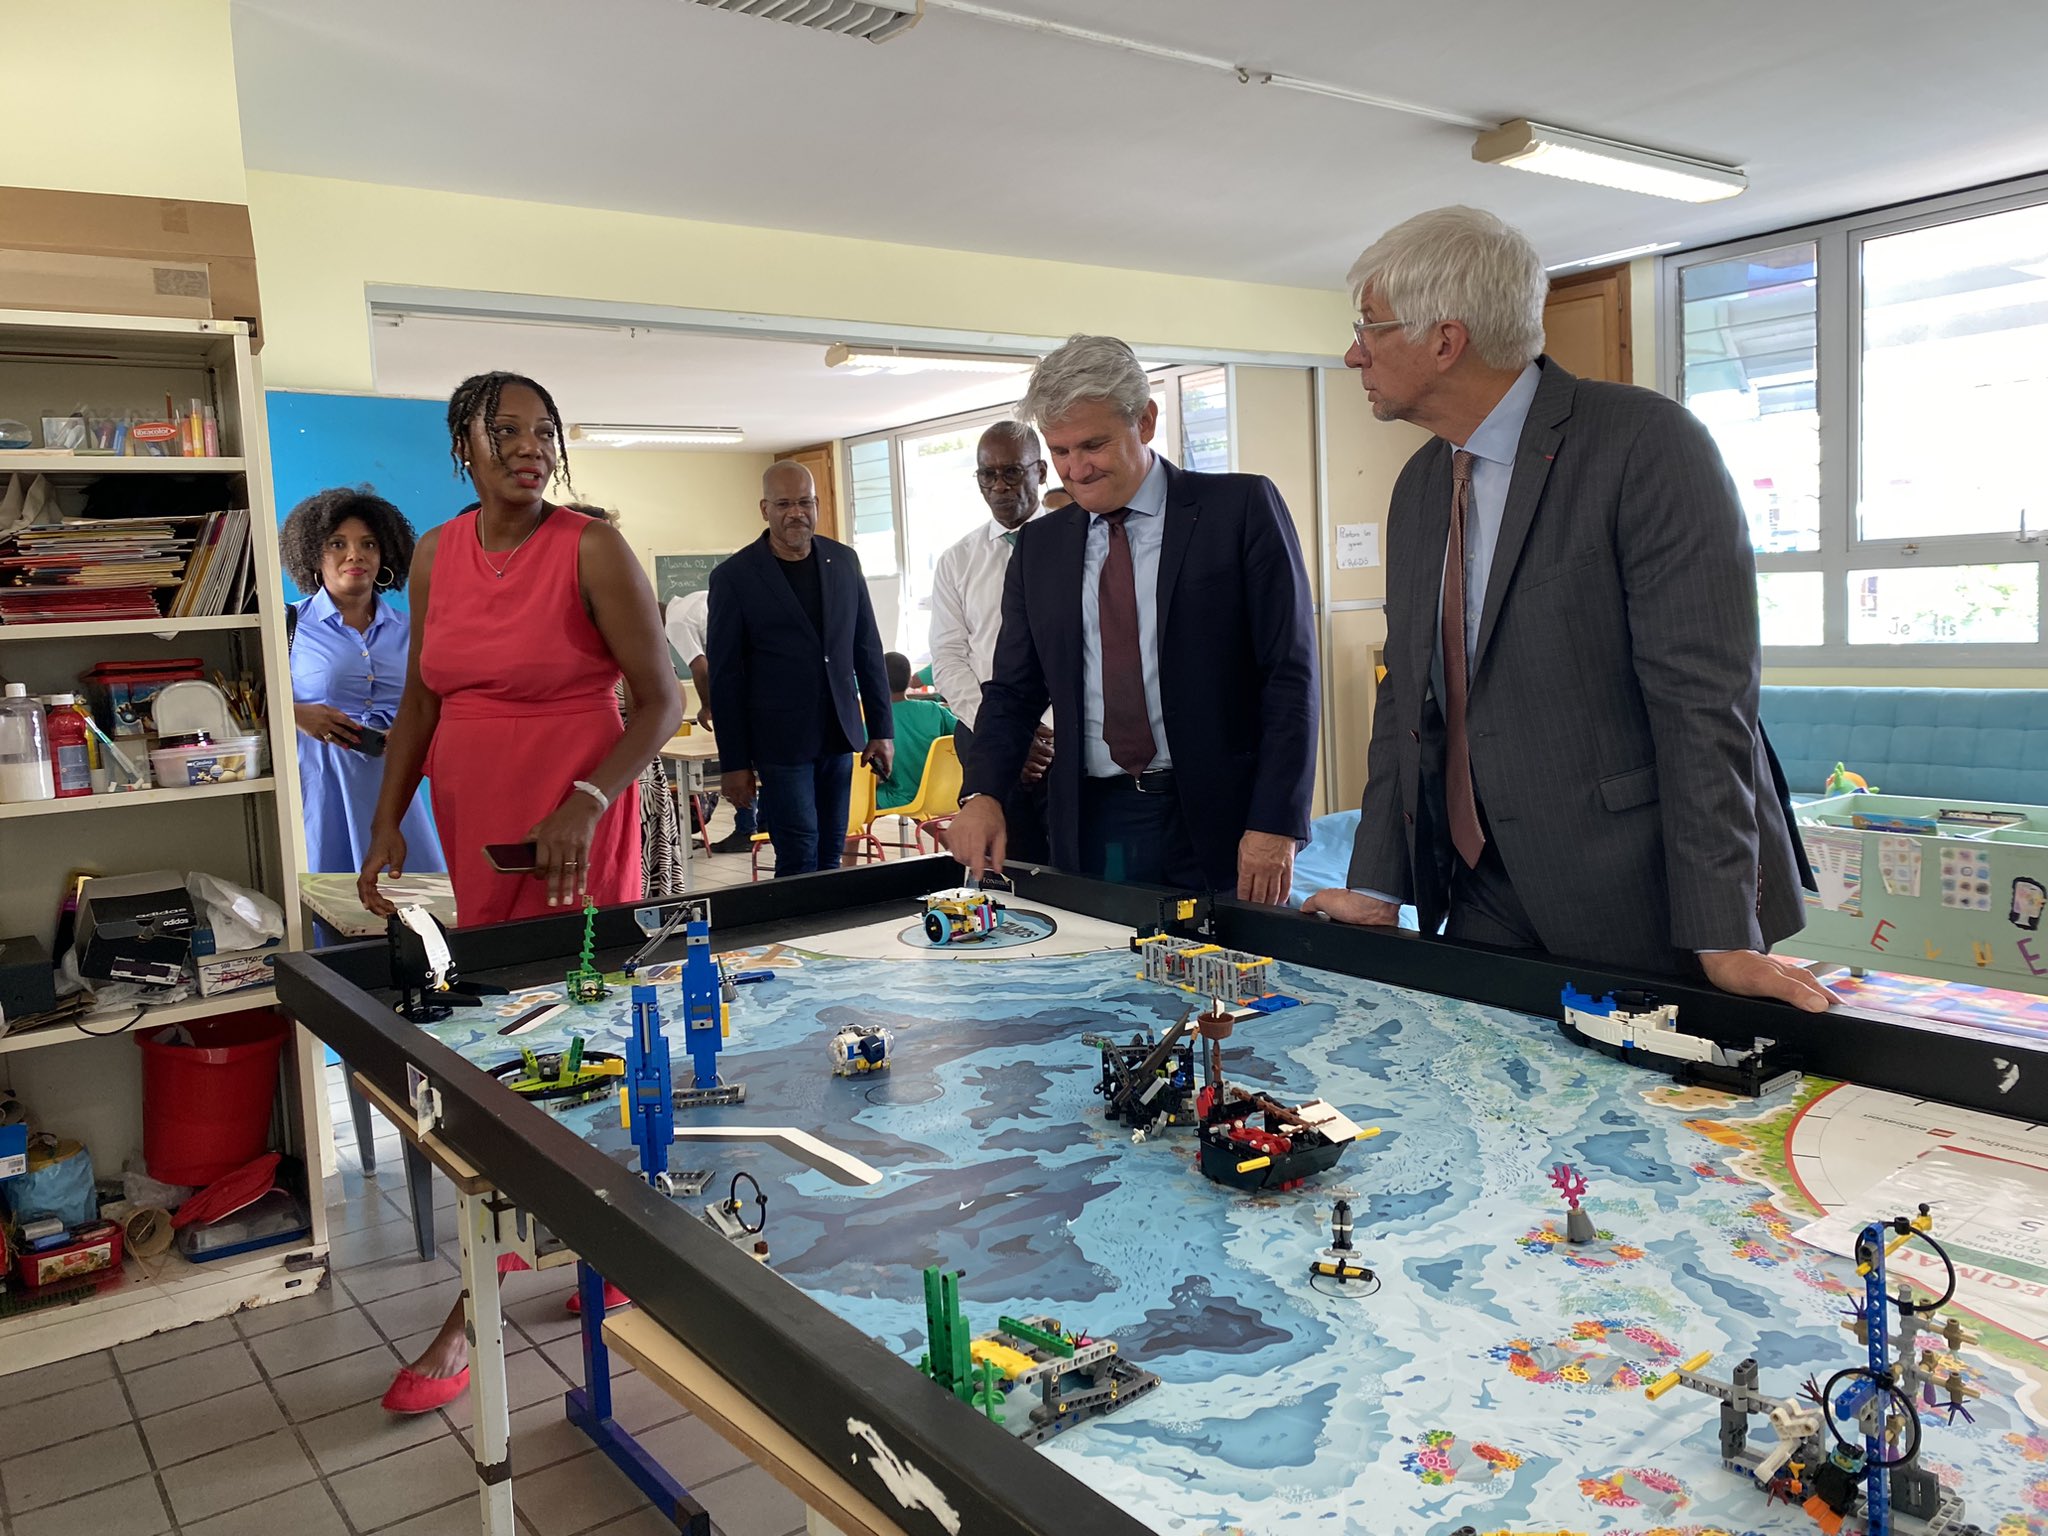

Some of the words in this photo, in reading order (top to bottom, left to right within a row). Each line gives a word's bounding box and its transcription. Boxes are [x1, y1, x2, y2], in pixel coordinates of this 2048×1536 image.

[135, 907, 187, 919] adidas
[162, 918, 190, 927] adidas
[2016, 1219, 2047, 1234] 5
